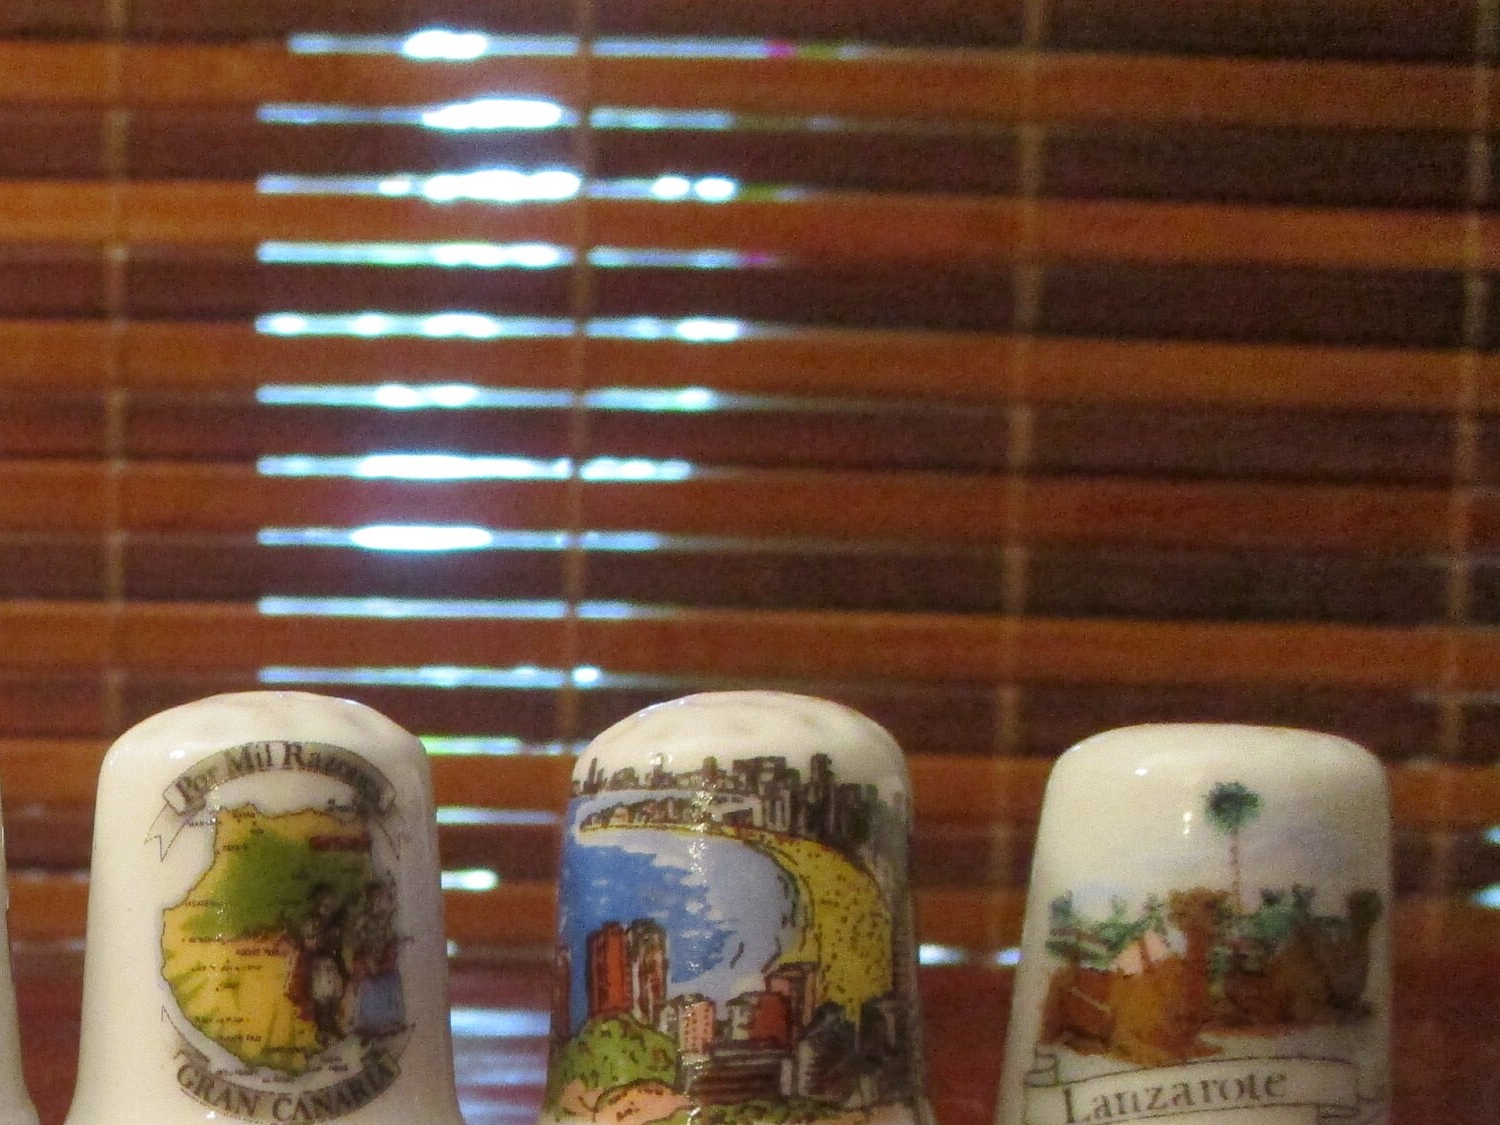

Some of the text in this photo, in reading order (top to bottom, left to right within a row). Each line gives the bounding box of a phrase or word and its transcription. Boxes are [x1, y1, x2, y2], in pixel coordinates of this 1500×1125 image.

[222, 742, 273, 783] Mil
[177, 1063, 262, 1118] GRAN
[1062, 1069, 1288, 1125] Lanzarote
